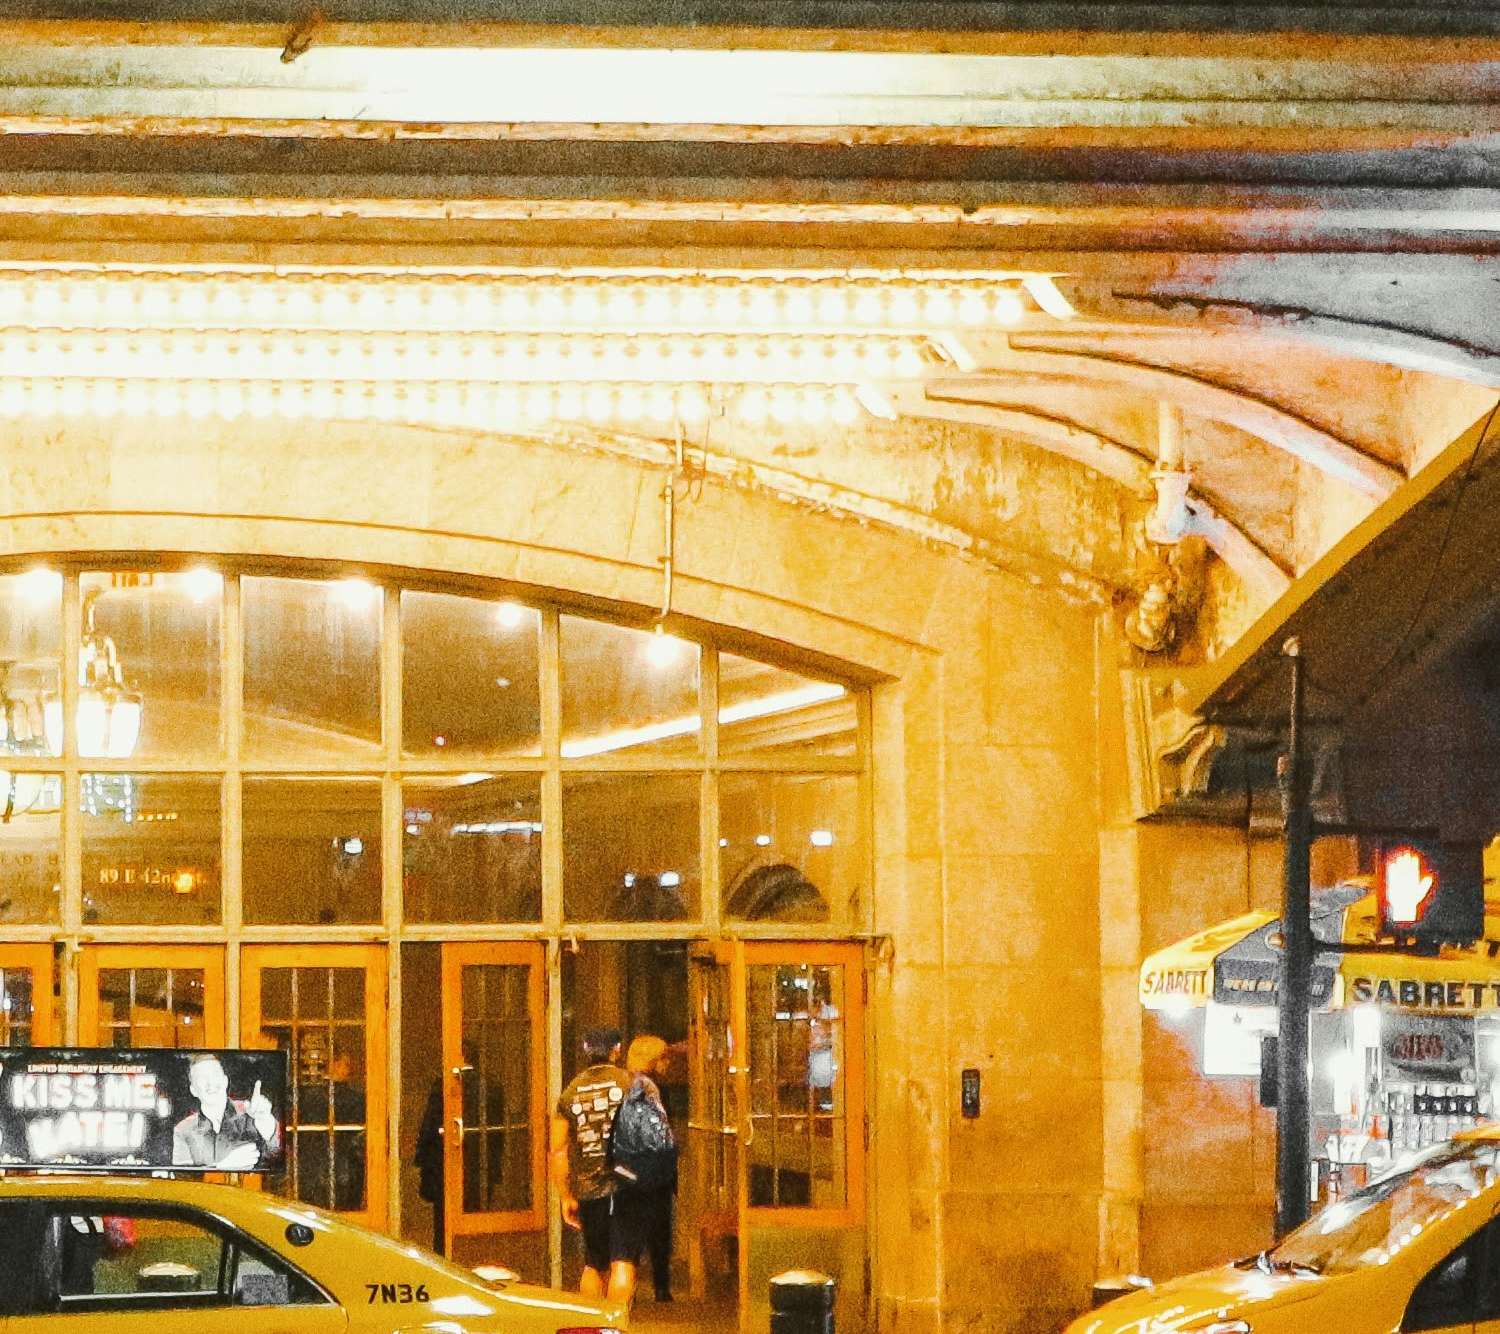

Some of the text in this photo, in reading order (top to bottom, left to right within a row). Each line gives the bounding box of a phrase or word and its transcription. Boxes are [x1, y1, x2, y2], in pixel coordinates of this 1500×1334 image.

[1143, 970, 1208, 995] SABRETT
[11, 1072, 171, 1119] KISS ME,
[364, 1283, 431, 1305] 7N36
